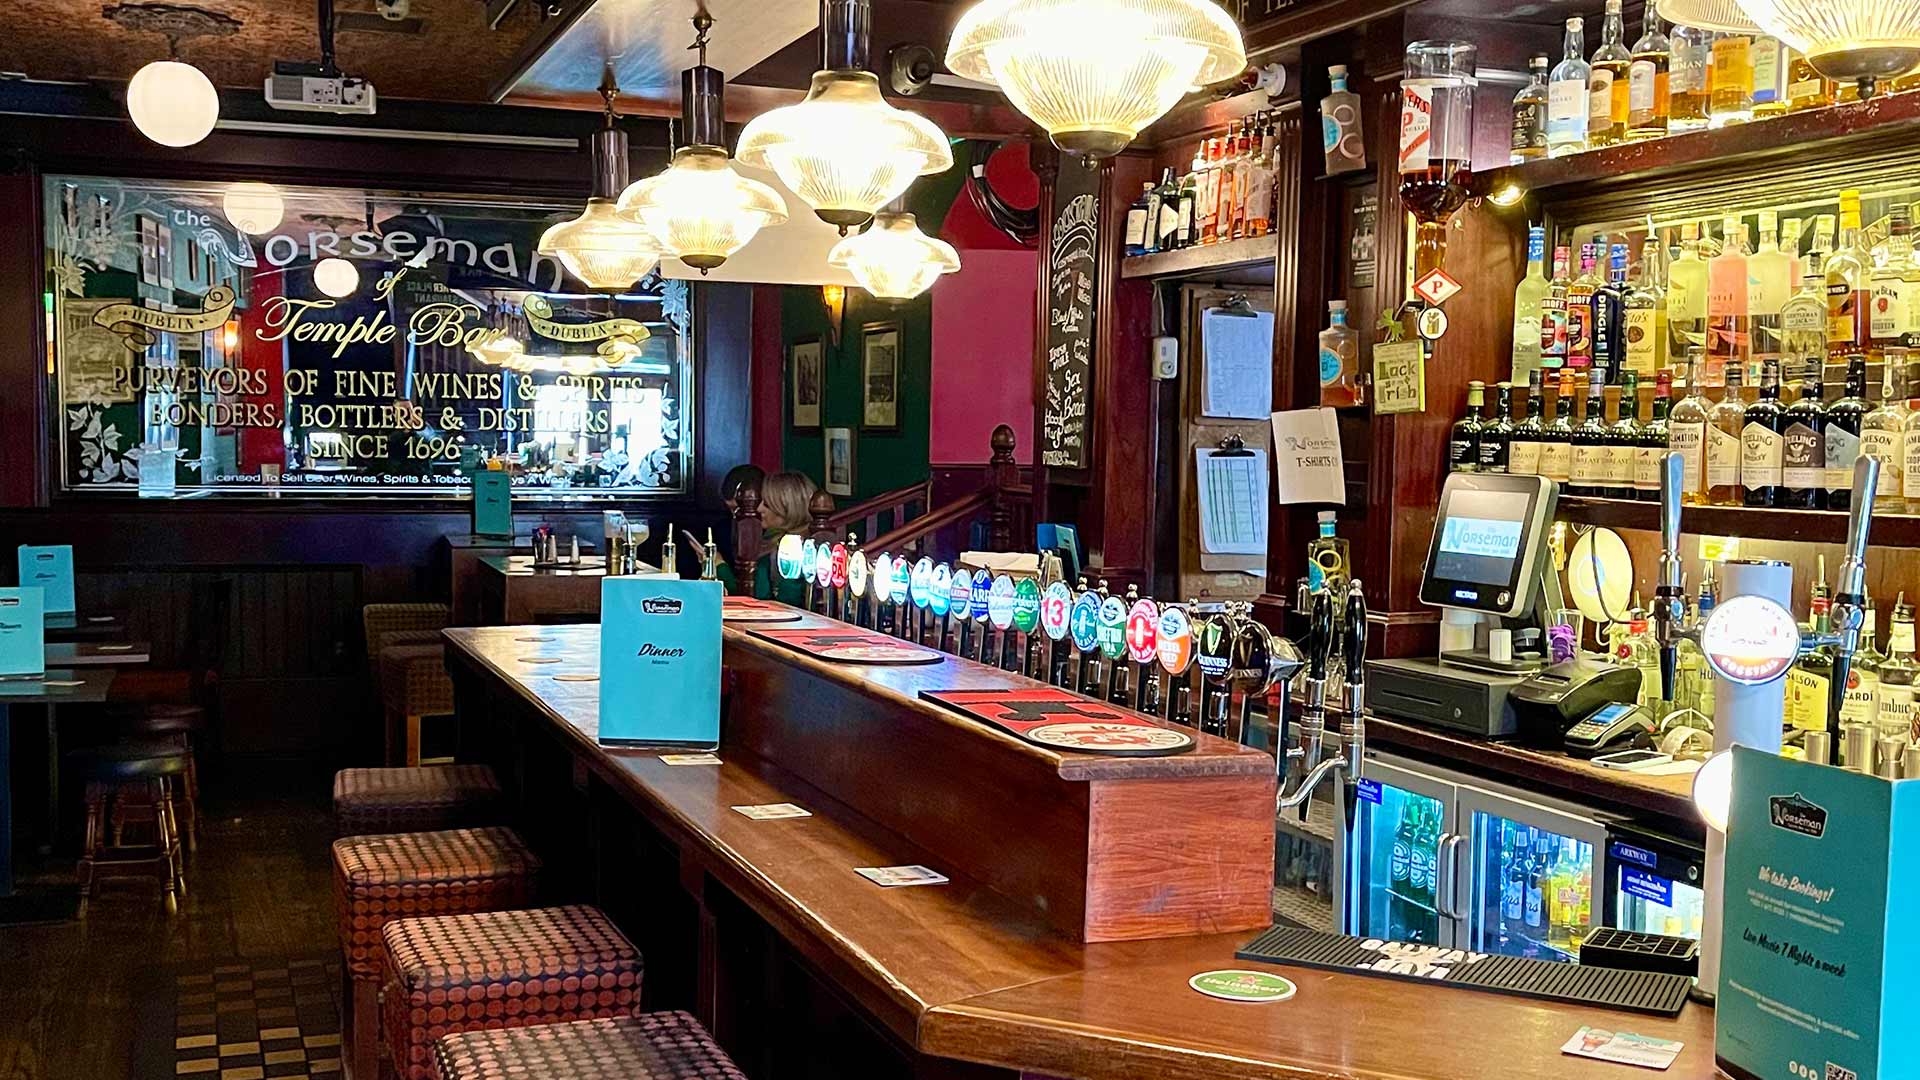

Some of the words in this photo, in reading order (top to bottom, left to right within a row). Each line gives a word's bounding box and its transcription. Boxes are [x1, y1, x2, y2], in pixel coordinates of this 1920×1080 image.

[173, 209, 211, 226] The
[373, 267, 408, 301] of
[1432, 280, 1443, 294] P
[132, 310, 195, 329] DUBLIN
[256, 296, 397, 359] Temple
[408, 302, 508, 347] Bar
[1597, 295, 1607, 342] DINGLE
[551, 323, 608, 339] DUBLIN
[112, 366, 268, 396] PURVEYORS
[284, 369, 318, 396] OF
[335, 370, 396, 398] FINE
[414, 372, 501, 400] WINES
[518, 376, 537, 401] &
[556, 376, 645, 404] SPIRITS
[152, 403, 284, 429] BONDERS,
[300, 404, 424, 429] BOTTLERS
[440, 407, 463, 431] &
[309, 435, 389, 460] SINCE
[405, 436, 462, 461] 1696
[1296, 456, 1331, 468] T-SHIRTS
[206, 474, 261, 483] Licensed
[281, 474, 303, 483] Sell
[383, 474, 419, 484] Spirits
[421, 475, 431, 484] &
[1041, 597, 1064, 627] 13
[637, 643, 687, 657] Dinner
[1881, 697, 1911, 714] mbuc
